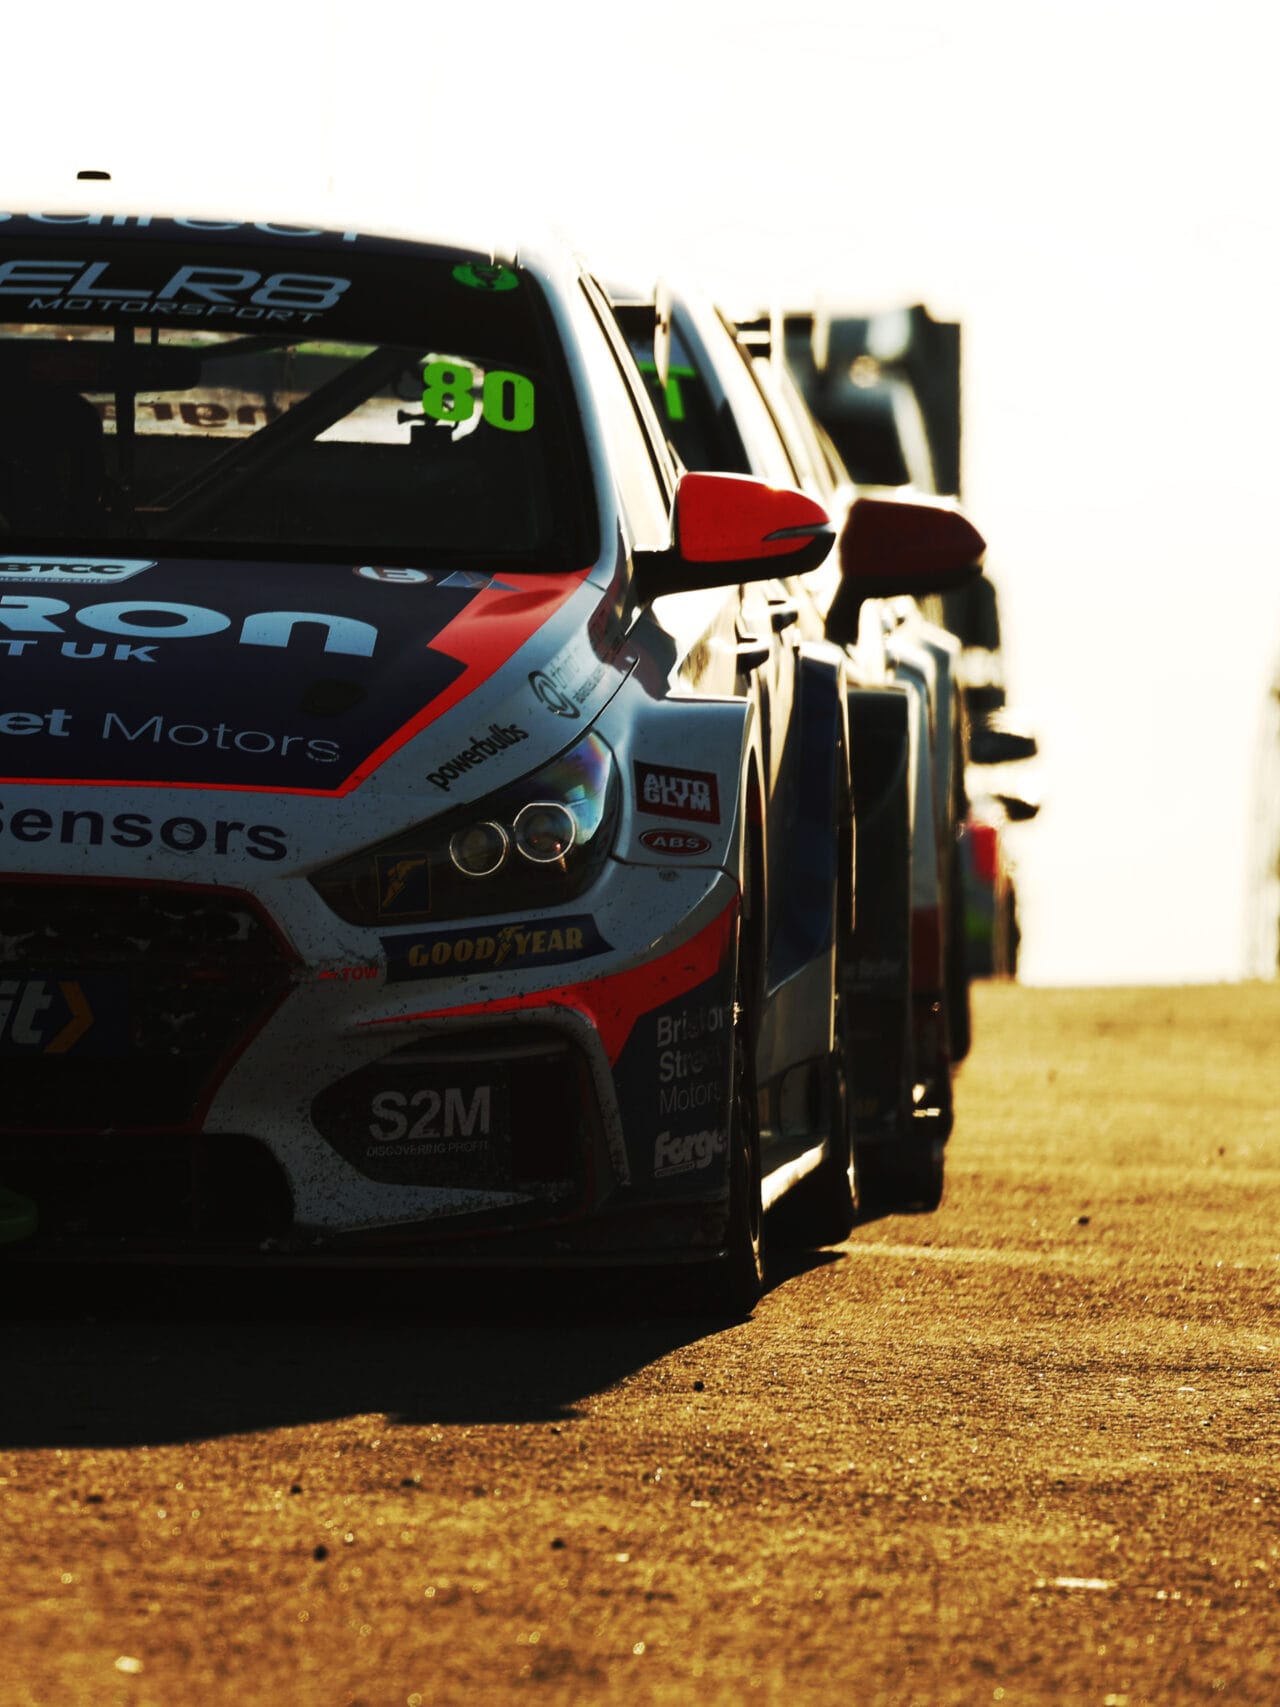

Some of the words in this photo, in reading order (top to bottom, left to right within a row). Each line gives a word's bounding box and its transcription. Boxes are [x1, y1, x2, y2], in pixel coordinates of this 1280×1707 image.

[28, 297, 324, 324] MOTORSPORT
[422, 361, 535, 432] 80
[60, 641, 160, 663] UK
[101, 711, 341, 763] Motors
[426, 722, 529, 792] powerbulbs
[652, 836, 699, 849] ABS
[342, 965, 379, 981] TOW
[368, 1086, 491, 1140] S2M
